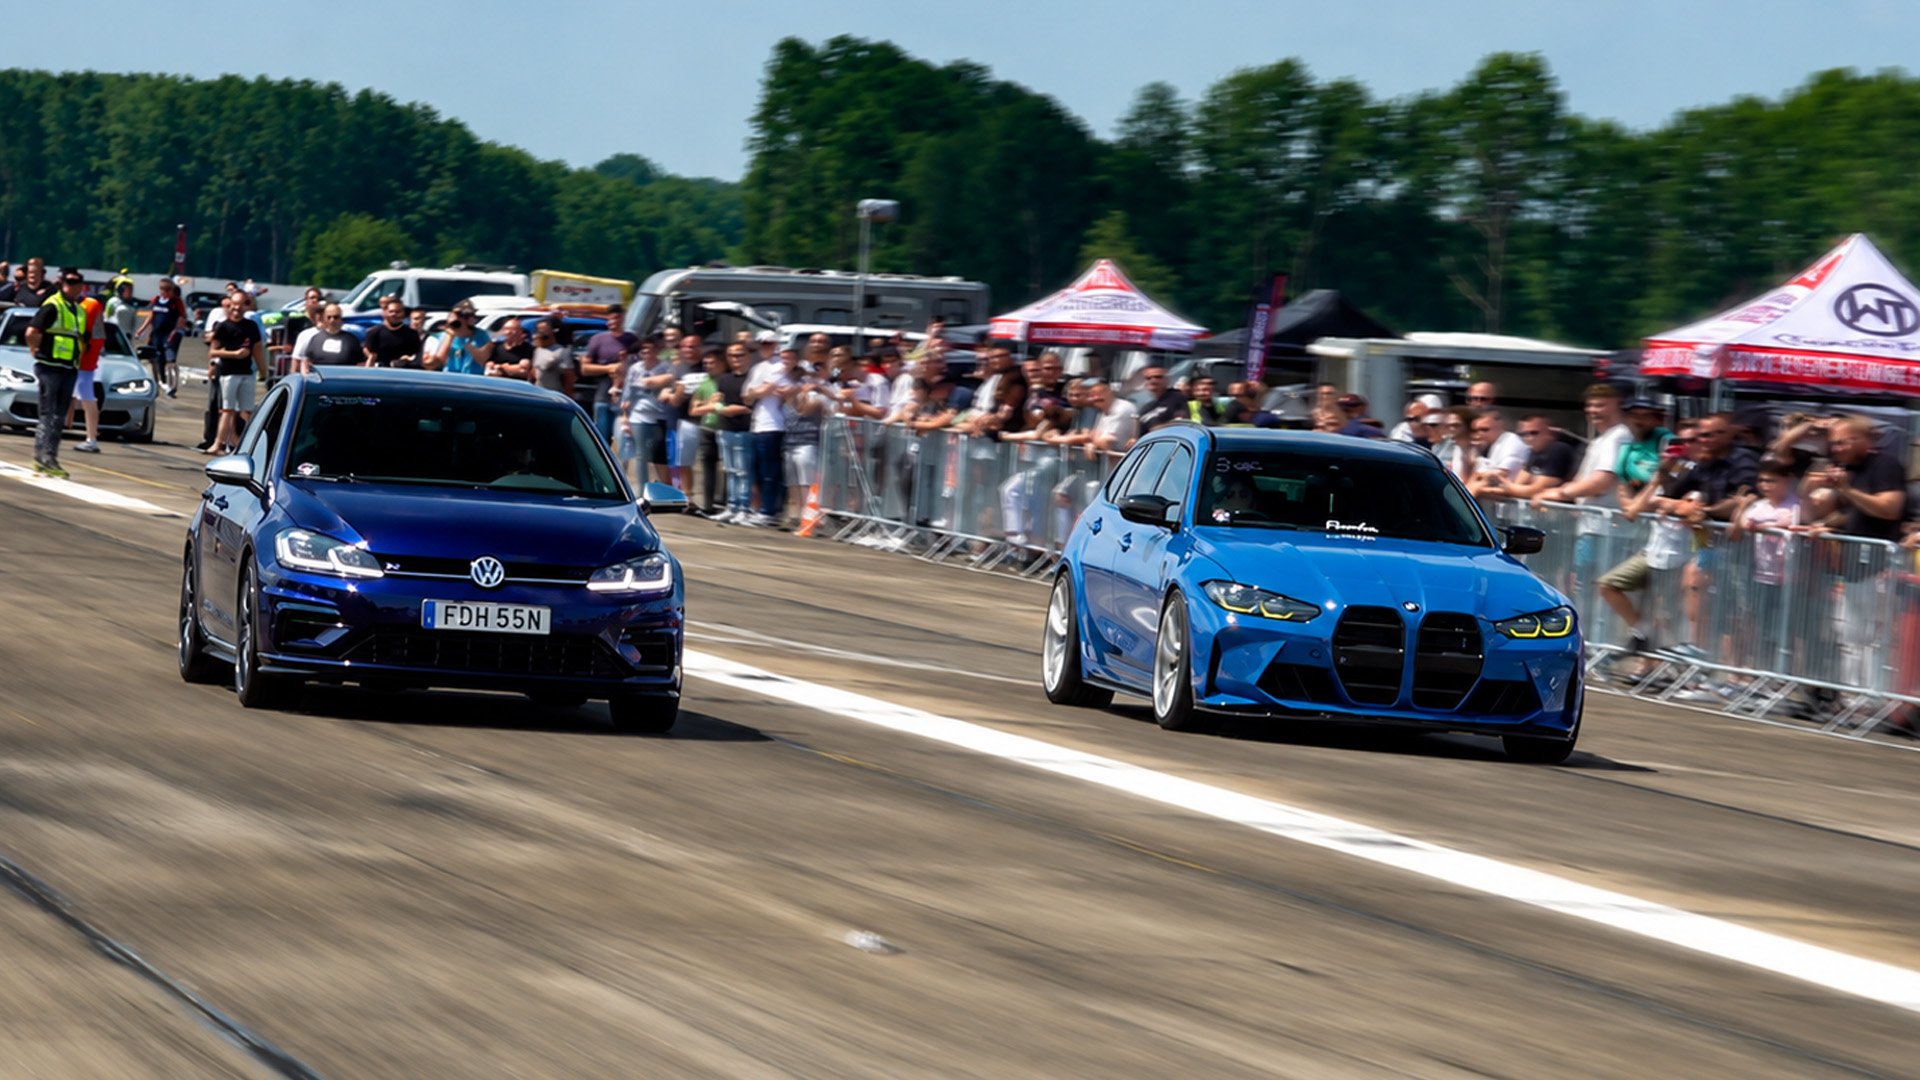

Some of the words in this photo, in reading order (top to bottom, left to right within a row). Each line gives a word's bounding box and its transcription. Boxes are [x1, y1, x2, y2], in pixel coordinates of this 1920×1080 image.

[1841, 287, 1917, 335] WT
[473, 558, 503, 586] VW
[444, 605, 489, 627] FDH
[496, 608, 541, 631] 55N
